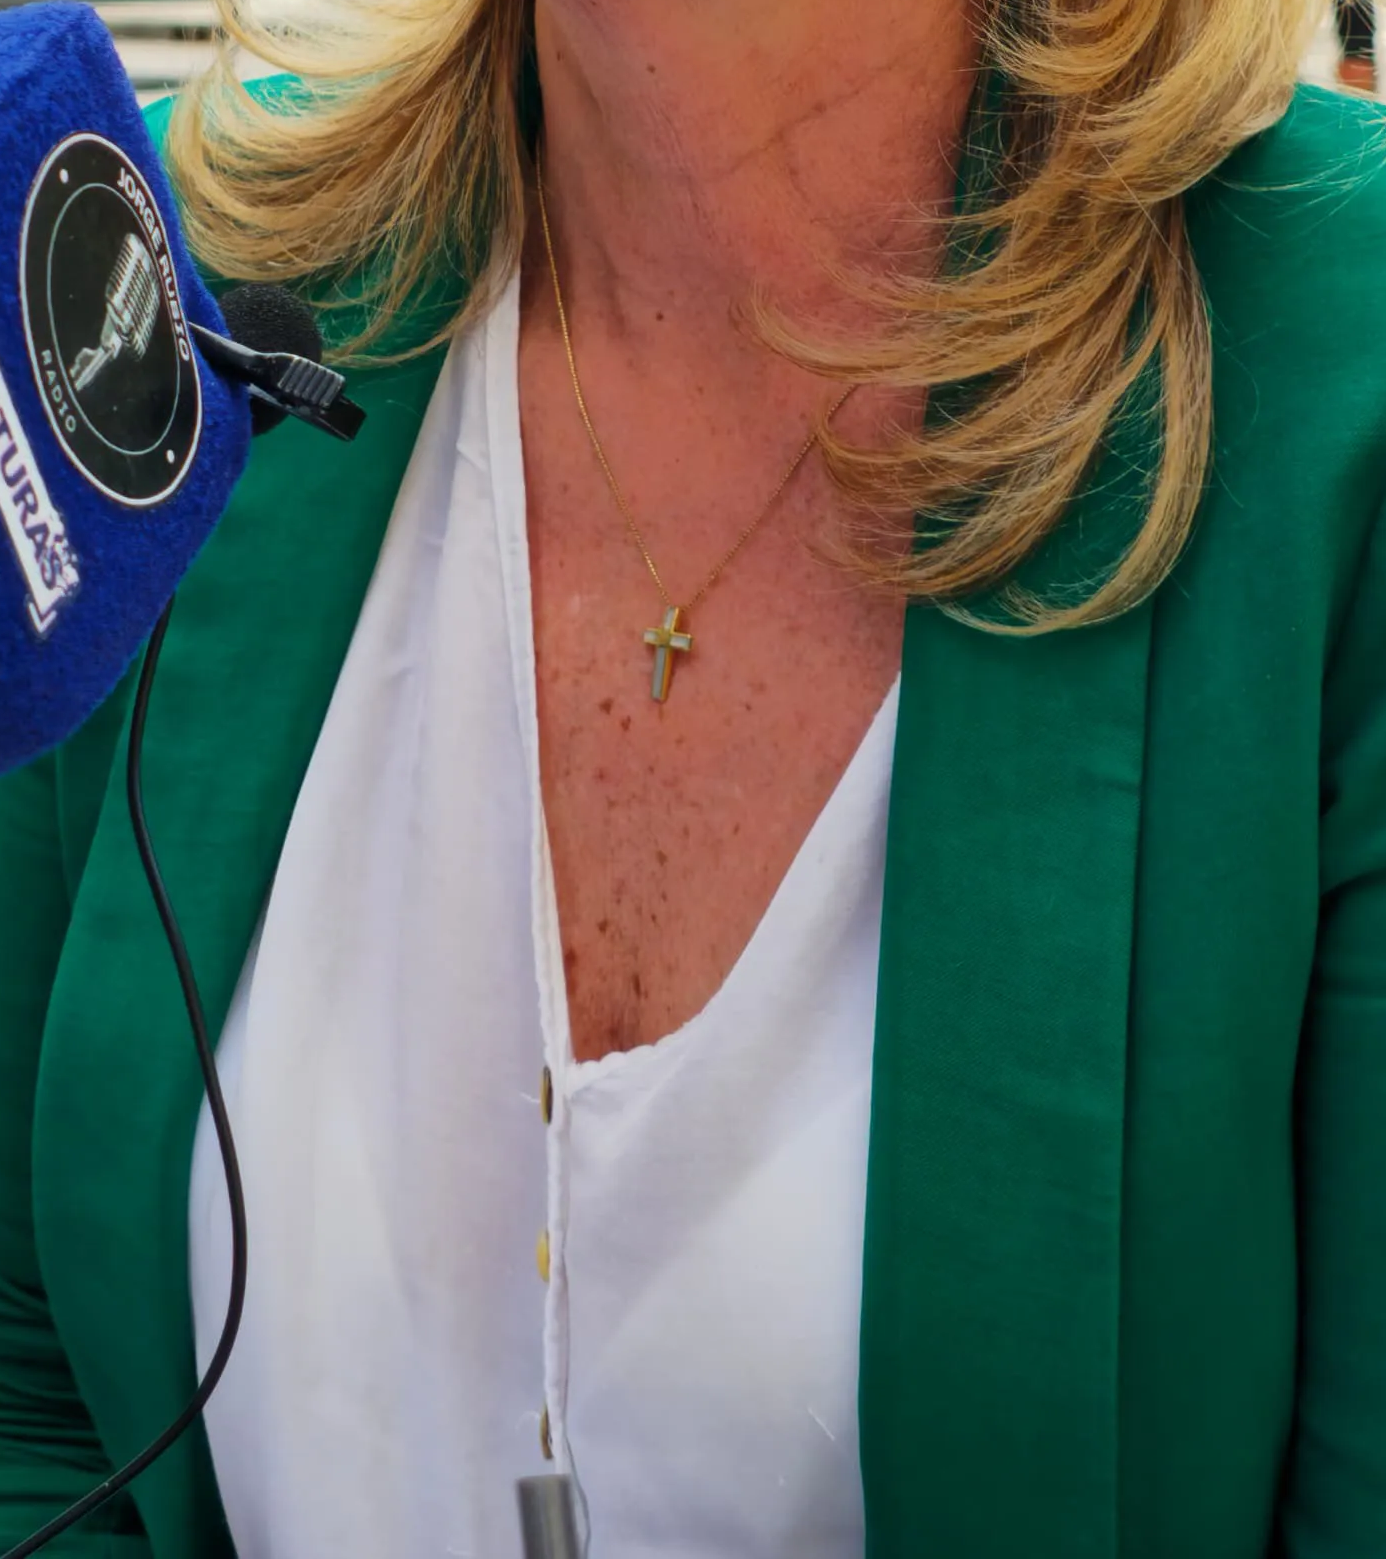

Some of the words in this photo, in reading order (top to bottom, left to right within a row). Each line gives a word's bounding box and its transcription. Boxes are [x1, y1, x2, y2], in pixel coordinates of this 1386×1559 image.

[116, 167, 163, 253] JORGE
[157, 253, 191, 363] RUBIO
[40, 348, 77, 434] RADIO
